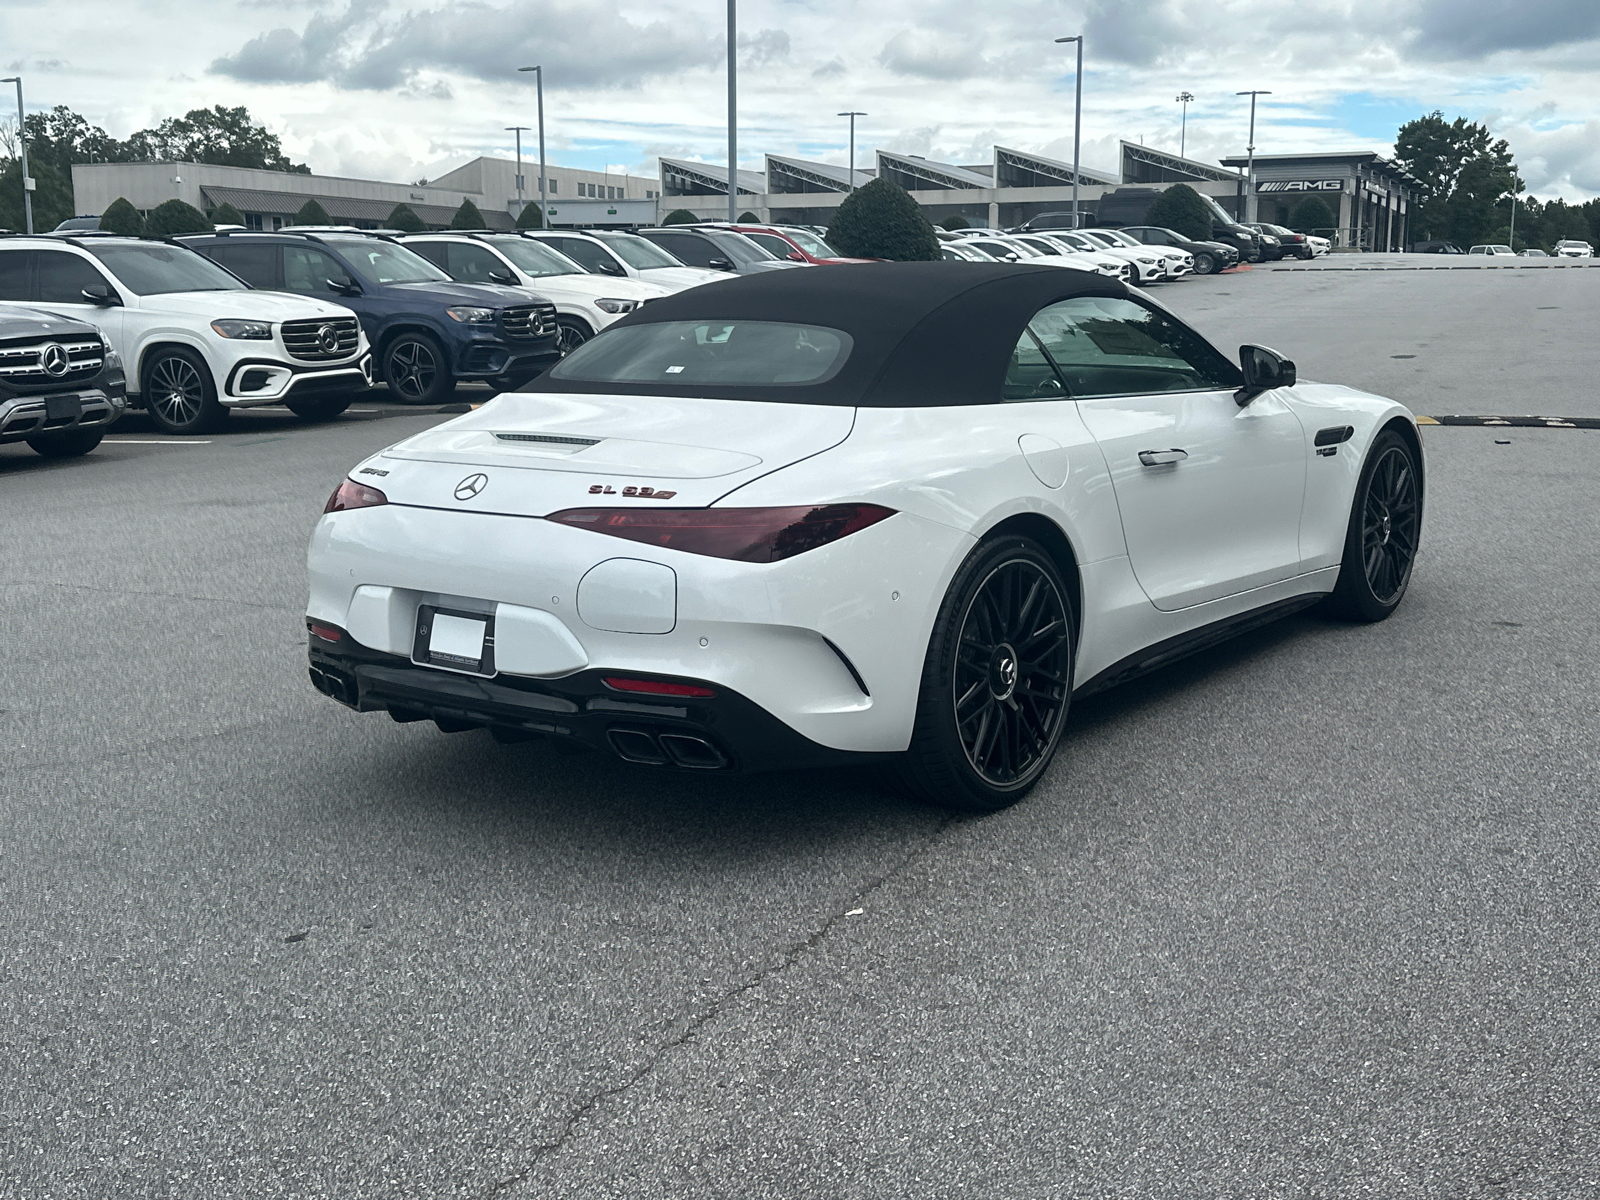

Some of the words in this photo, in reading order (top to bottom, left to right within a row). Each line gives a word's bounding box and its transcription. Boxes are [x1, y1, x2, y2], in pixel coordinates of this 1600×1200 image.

[1283, 179, 1342, 191] AMG
[588, 485, 617, 494] SL
[621, 486, 655, 497] 63
